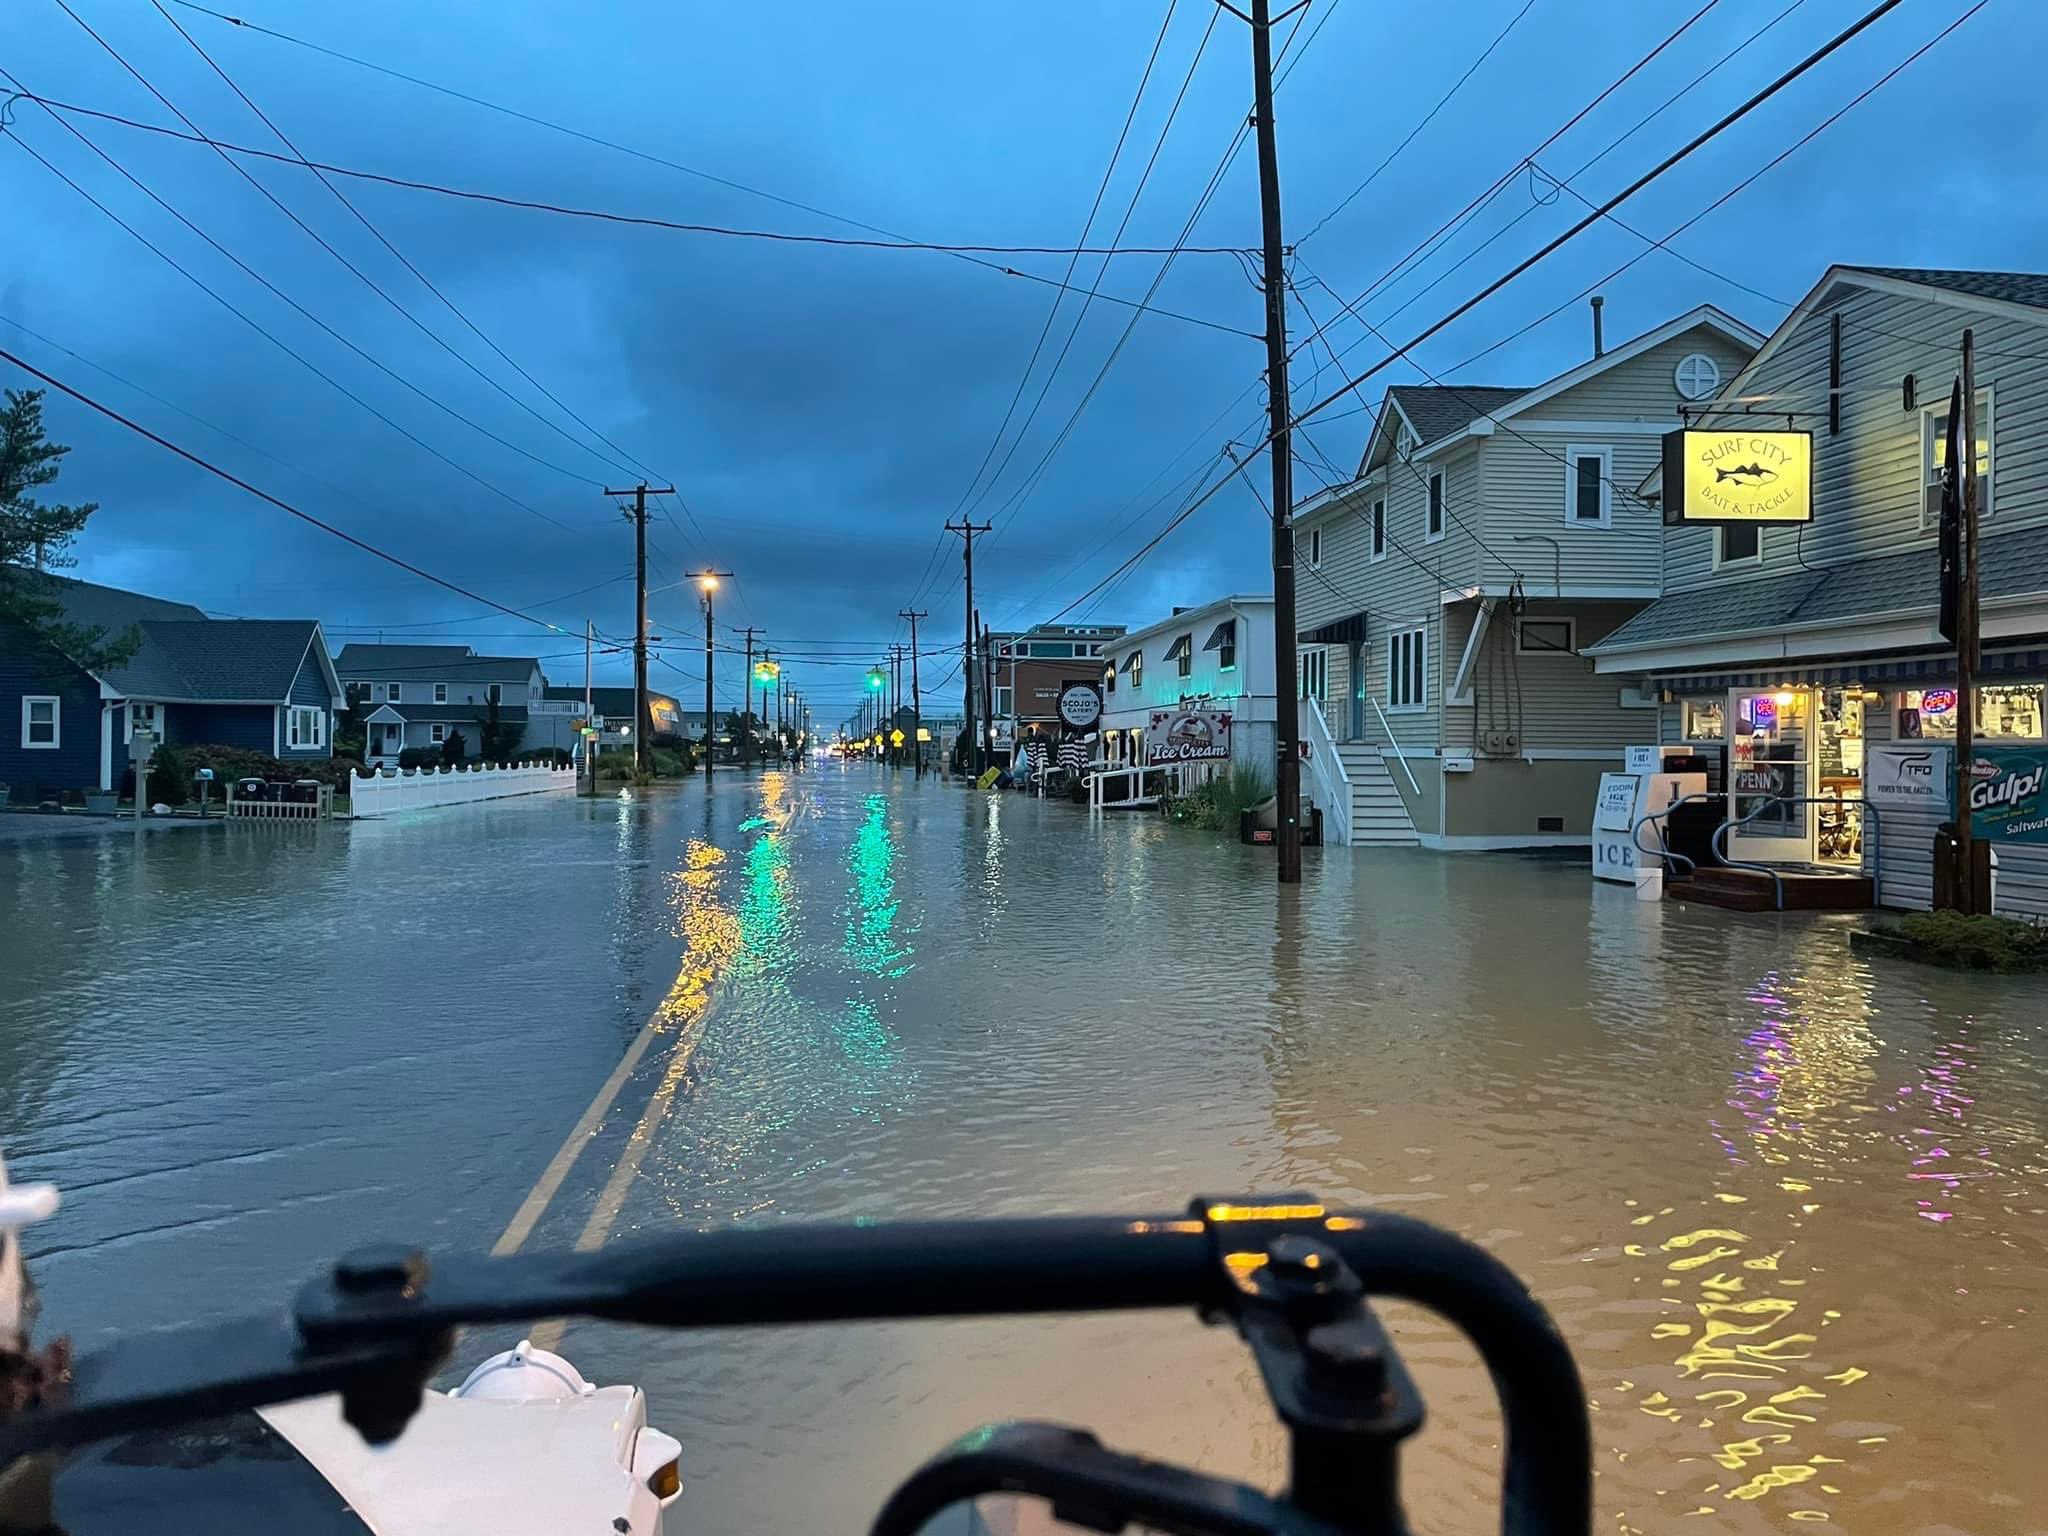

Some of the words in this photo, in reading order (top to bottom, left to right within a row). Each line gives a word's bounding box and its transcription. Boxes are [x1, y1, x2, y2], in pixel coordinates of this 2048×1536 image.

[1701, 438, 1745, 467] SURF
[1750, 438, 1793, 465] CITY
[1701, 486, 1730, 511] BAIT
[1732, 502, 1743, 514] &
[1747, 487, 1794, 515] TACKLE
[1924, 692, 1951, 710] OPEN
[1152, 744, 1178, 760] Ice
[1179, 743, 1227, 759] Cream
[1906, 765, 1933, 776] TFO
[1607, 783, 1634, 793] EDDIN
[1740, 773, 1772, 789] PENN
[1970, 767, 2043, 810] Gulp!
[1598, 843, 1635, 868] ICE
